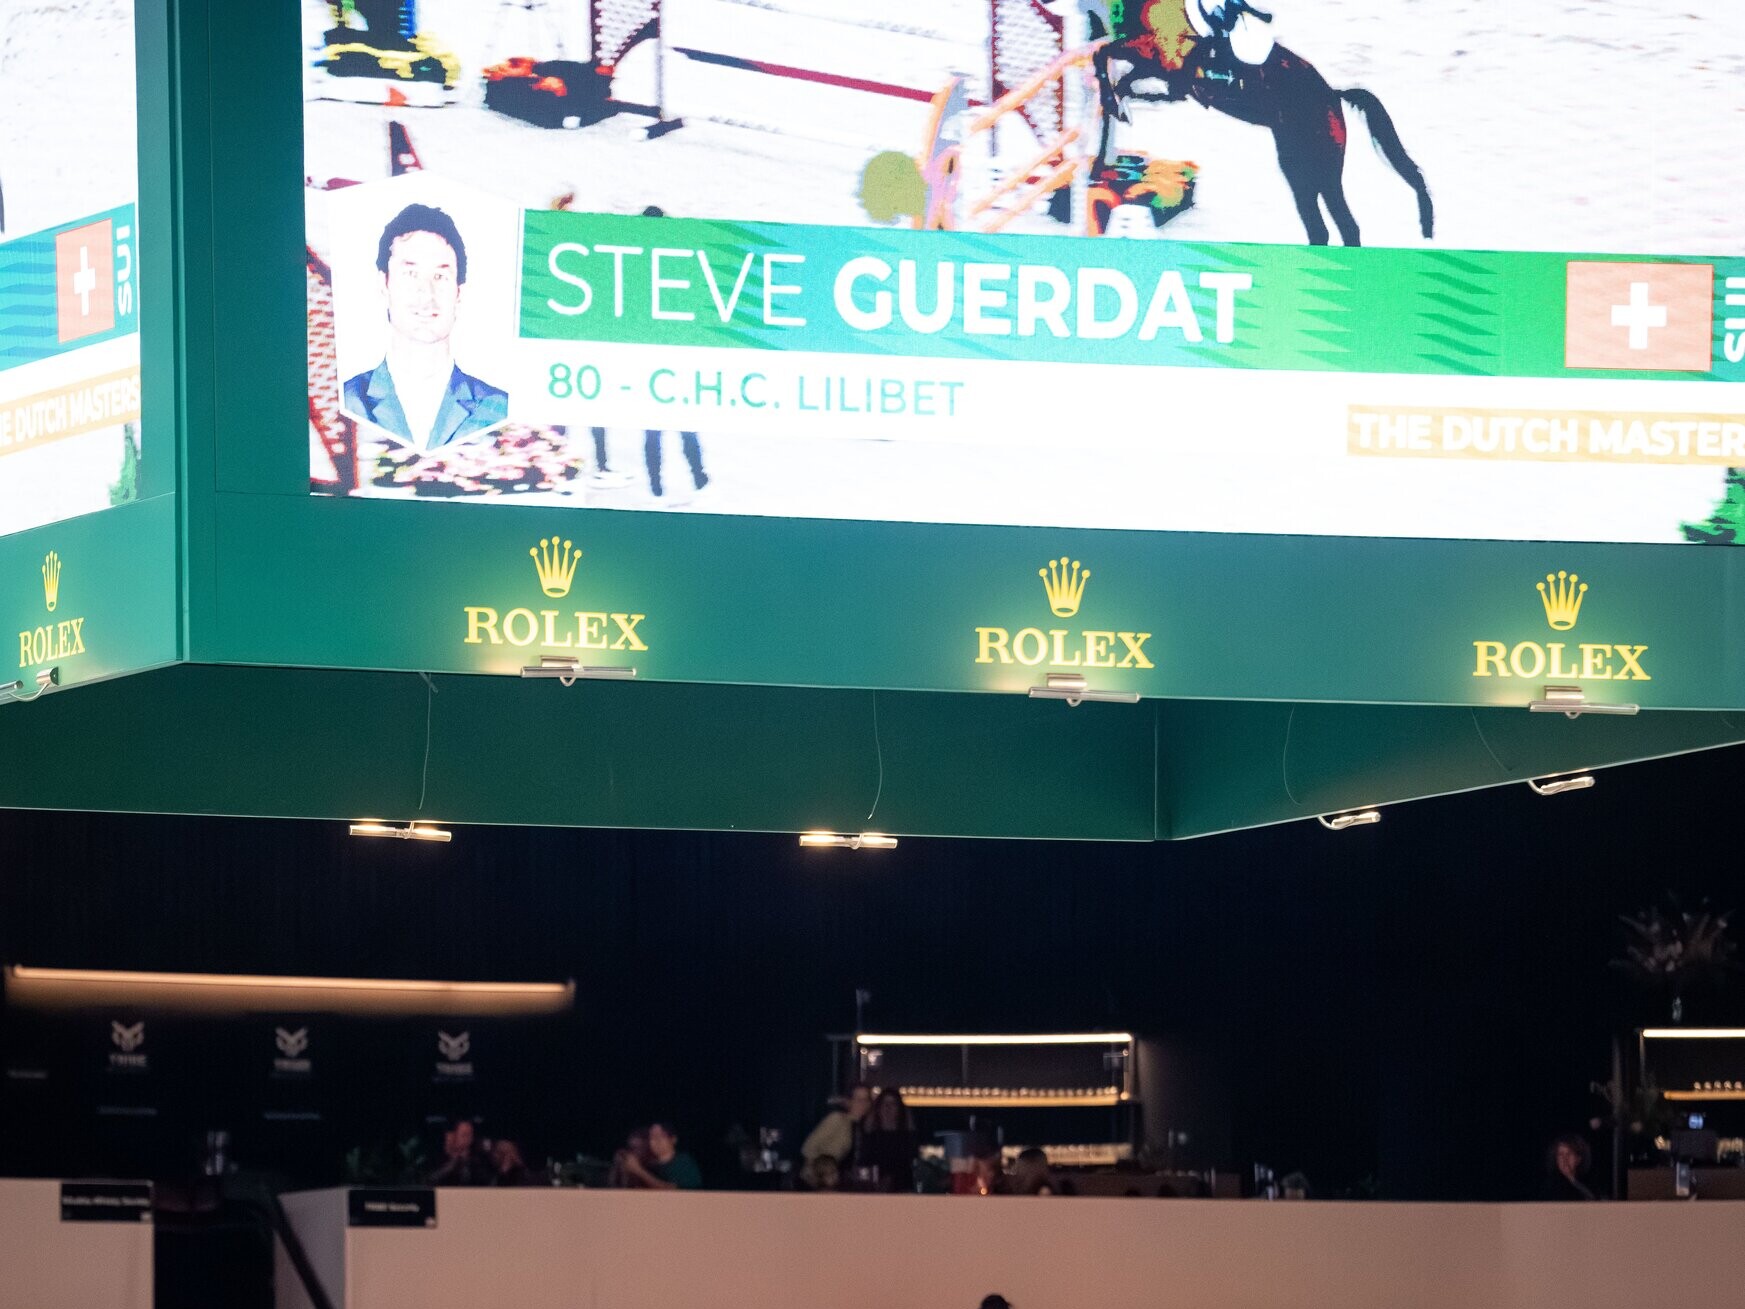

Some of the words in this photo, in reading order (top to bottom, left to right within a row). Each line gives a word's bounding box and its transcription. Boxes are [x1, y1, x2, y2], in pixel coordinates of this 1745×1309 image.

[116, 224, 133, 317] SUI
[547, 242, 807, 327] STEVE
[833, 256, 1253, 344] GUERDAT
[15, 391, 67, 443] DUTCH
[69, 375, 139, 427] MASTERS
[548, 363, 601, 400] 80
[649, 368, 780, 409] C.H.C.
[798, 375, 964, 416] LILIBET
[1352, 412, 1433, 451] THE
[1443, 415, 1580, 455] DUTCH
[19, 617, 86, 668] ROLEX
[463, 606, 649, 652] ROLEX
[975, 627, 1154, 670] ROLEX
[1472, 640, 1652, 682] ROLEX
